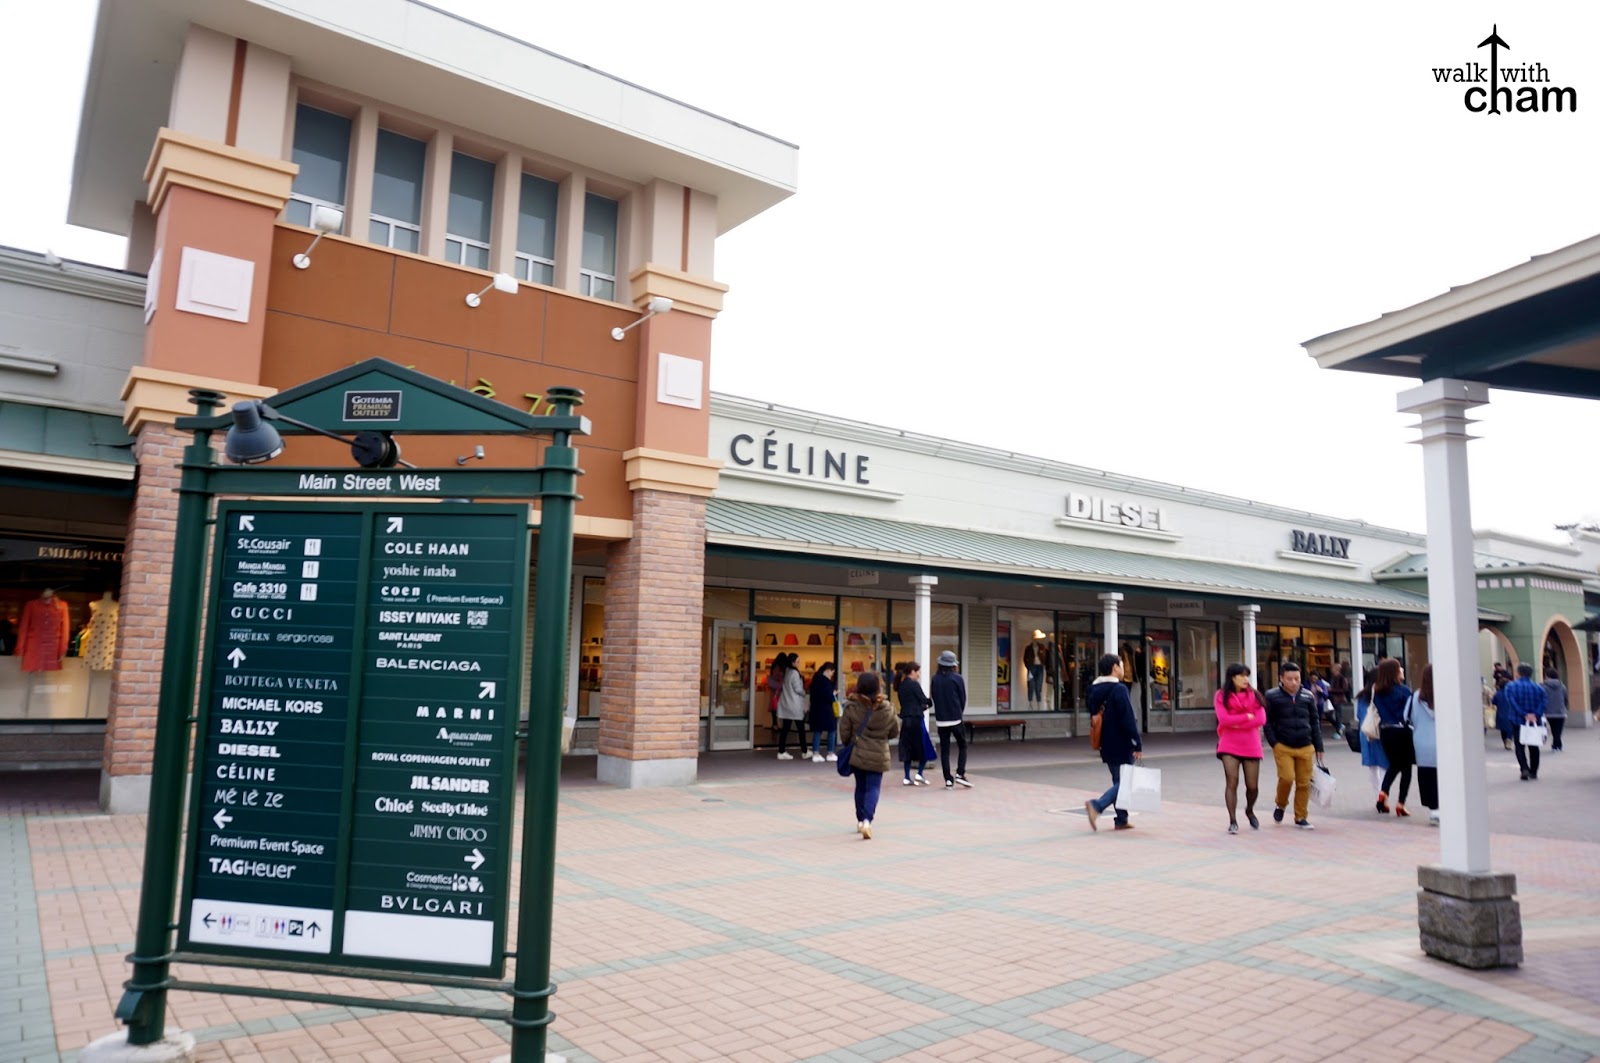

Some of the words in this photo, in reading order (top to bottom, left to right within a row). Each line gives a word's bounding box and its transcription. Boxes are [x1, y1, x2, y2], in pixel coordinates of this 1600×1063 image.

[351, 395, 394, 404] GOTEMBA
[730, 429, 870, 485] CÉLINE
[298, 474, 337, 490] Main
[342, 474, 392, 490] Street
[399, 474, 441, 491] West
[1065, 492, 1174, 532] DIESEL
[384, 542, 424, 555] COLE
[428, 543, 470, 556] HAAN
[1291, 529, 1352, 559] BALLY
[38, 546, 88, 560] EMILIO
[382, 562, 420, 579] yoshie
[423, 564, 457, 578] inaba
[233, 581, 258, 593] Cafe
[258, 582, 288, 594] 3310
[380, 586, 421, 597] coen
[460, 595, 480, 604] Event
[230, 606, 293, 621] GUCCI
[379, 611, 415, 624] ISSEY
[415, 611, 461, 625] MIYAKE
[378, 631, 403, 641] SAINT
[403, 633, 443, 643] LAURENT
[396, 642, 423, 650] PARIS
[375, 657, 482, 672] BALENCIAGA
[224, 674, 284, 689] BOTTEGA
[287, 677, 339, 691] VENETA
[222, 697, 282, 712] MICHAEL
[285, 700, 324, 714] KORS
[416, 705, 495, 721] MARNI
[219, 718, 280, 736] BALLY
[217, 743, 282, 758] DIESEL
[371, 752, 399, 762] ROYAL
[399, 753, 457, 765] COPENHAGEN
[458, 757, 492, 767] OUTLET
[216, 762, 276, 782] CÉLINE
[410, 775, 431, 790] JIL
[431, 776, 490, 794] SANDER
[374, 797, 415, 814] Chloé
[410, 823, 445, 839] JIMMY
[446, 826, 488, 842] CHOO
[210, 834, 258, 850] Premium
[259, 838, 290, 852] Event
[291, 840, 325, 856] Space
[406, 871, 453, 885] Cosmetics
[380, 894, 484, 915] BVLGARI
